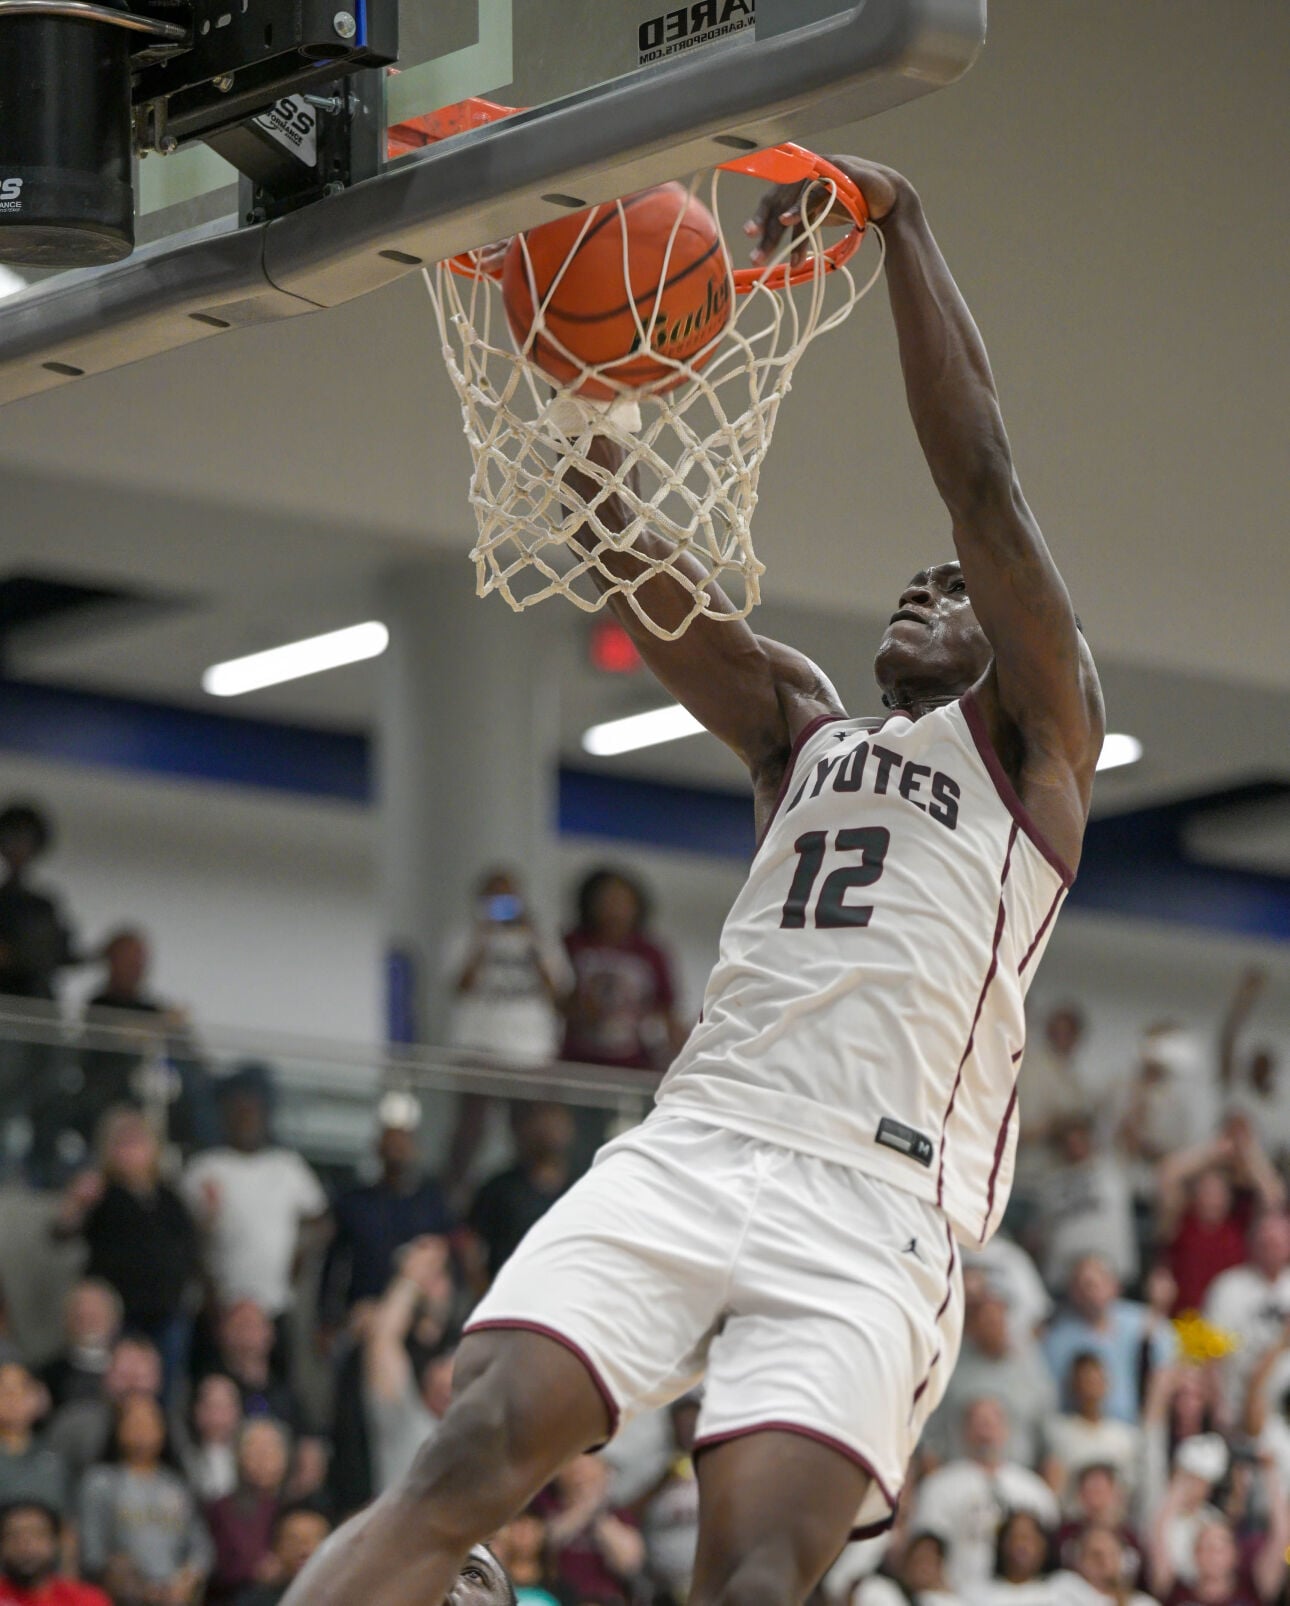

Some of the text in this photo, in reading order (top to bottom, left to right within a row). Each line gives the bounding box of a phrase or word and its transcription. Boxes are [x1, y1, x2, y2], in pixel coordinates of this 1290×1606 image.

[273, 98, 315, 135] SS
[0, 178, 23, 200] S
[786, 741, 961, 831] YOTES
[780, 826, 890, 929] 12
